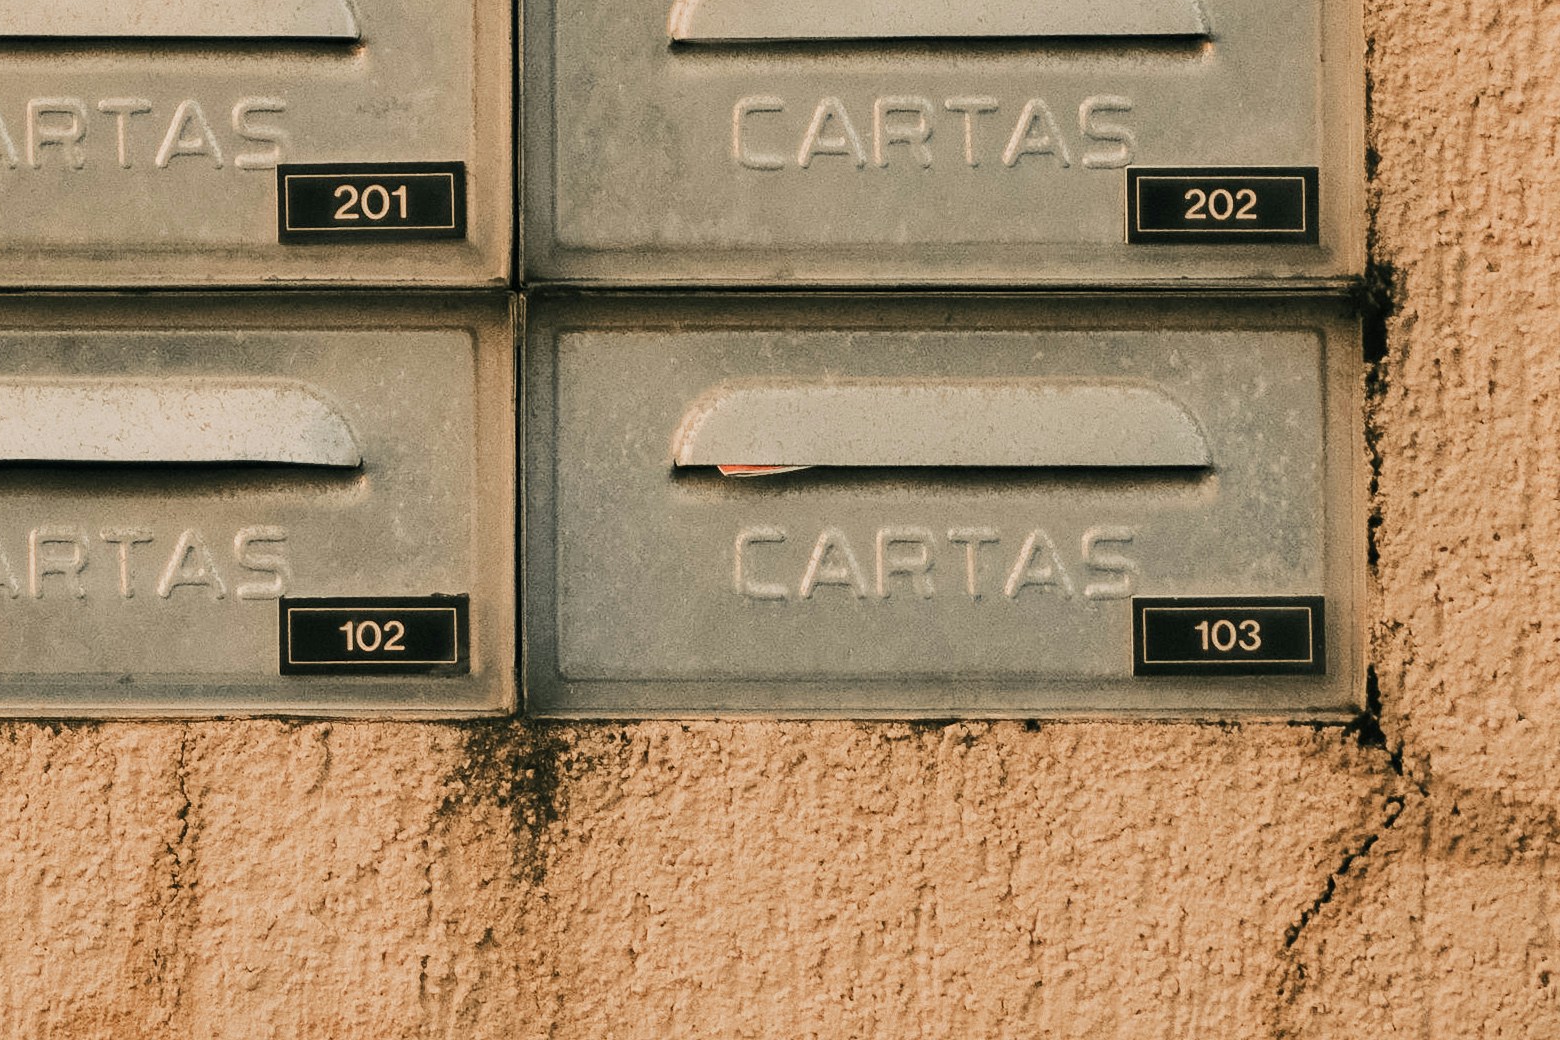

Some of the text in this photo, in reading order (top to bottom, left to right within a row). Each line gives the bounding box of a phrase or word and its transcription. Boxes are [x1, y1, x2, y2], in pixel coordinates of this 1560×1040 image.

[735, 93, 1134, 170] CARTAS
[333, 184, 407, 220] 201
[1184, 188, 1258, 221] 202
[737, 524, 1136, 601] CARTAS
[339, 620, 406, 652] 102
[1194, 619, 1262, 652] 103
